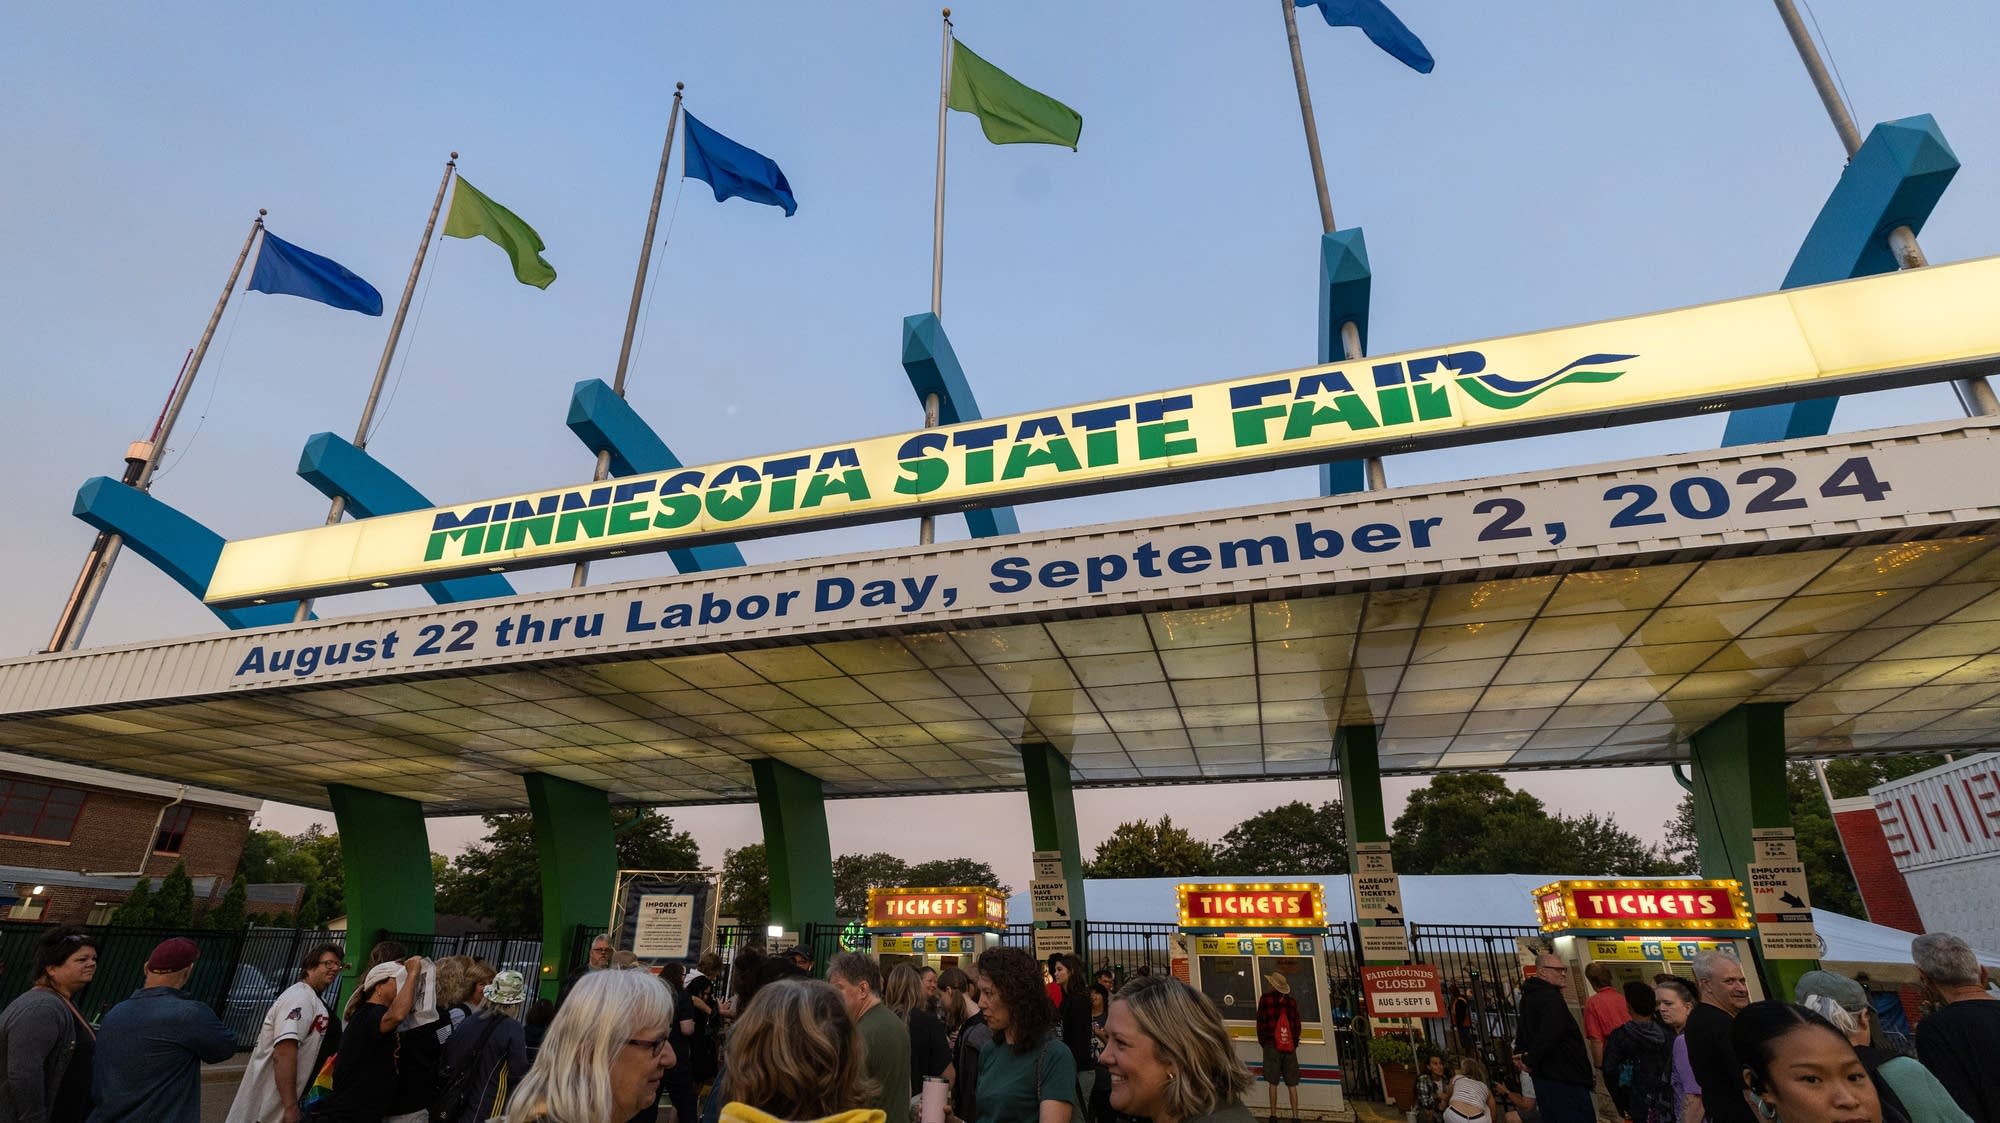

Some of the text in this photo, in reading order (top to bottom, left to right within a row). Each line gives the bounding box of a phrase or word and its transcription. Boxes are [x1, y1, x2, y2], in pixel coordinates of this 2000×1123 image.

[424, 350, 1490, 562] MINNESOTA STATE FAIR
[235, 456, 1892, 676] August 22 thru Labor Day, September 2, 2024
[886, 899, 968, 915] TICKETS
[1200, 896, 1301, 914] TICKETS
[1588, 895, 1717, 914] TICKETS
[914, 940, 924, 949] 16
[937, 940, 948, 949] 13
[962, 940, 972, 949] 13
[1240, 941, 1253, 951] 16
[1269, 941, 1282, 951] 13
[1299, 941, 1312, 951] 13
[1645, 944, 1661, 956] 16
[1682, 945, 1697, 956] 13
[1366, 969, 1434, 981] FAIRGROUNDS
[1376, 979, 1426, 989] CLOSED
[1379, 997, 1431, 1006] AUG 5-SEPT 6
